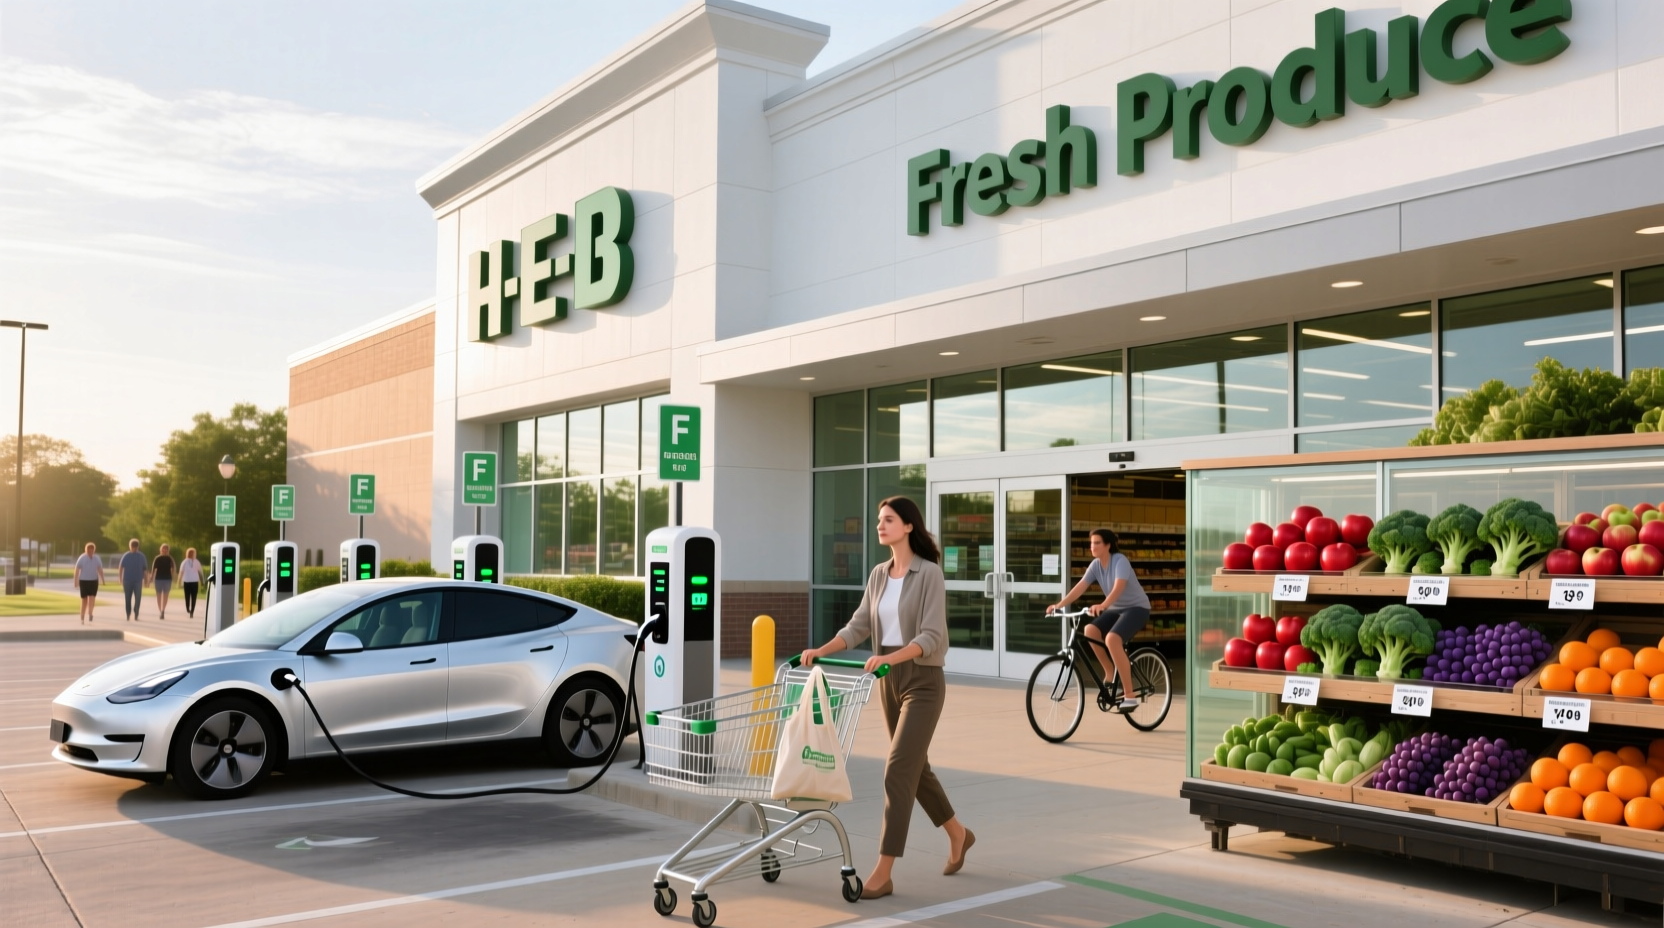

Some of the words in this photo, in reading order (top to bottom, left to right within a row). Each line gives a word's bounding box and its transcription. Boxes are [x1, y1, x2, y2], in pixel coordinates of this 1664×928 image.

[907, 104, 1098, 236] Fresh
[1117, 0, 1572, 176] Produce
[468, 186, 635, 342] H-E-B
[672, 414, 690, 445] F
[473, 459, 487, 481] F
[279, 489, 289, 504] F
[357, 478, 369, 496] F
[221, 500, 230, 512] F
